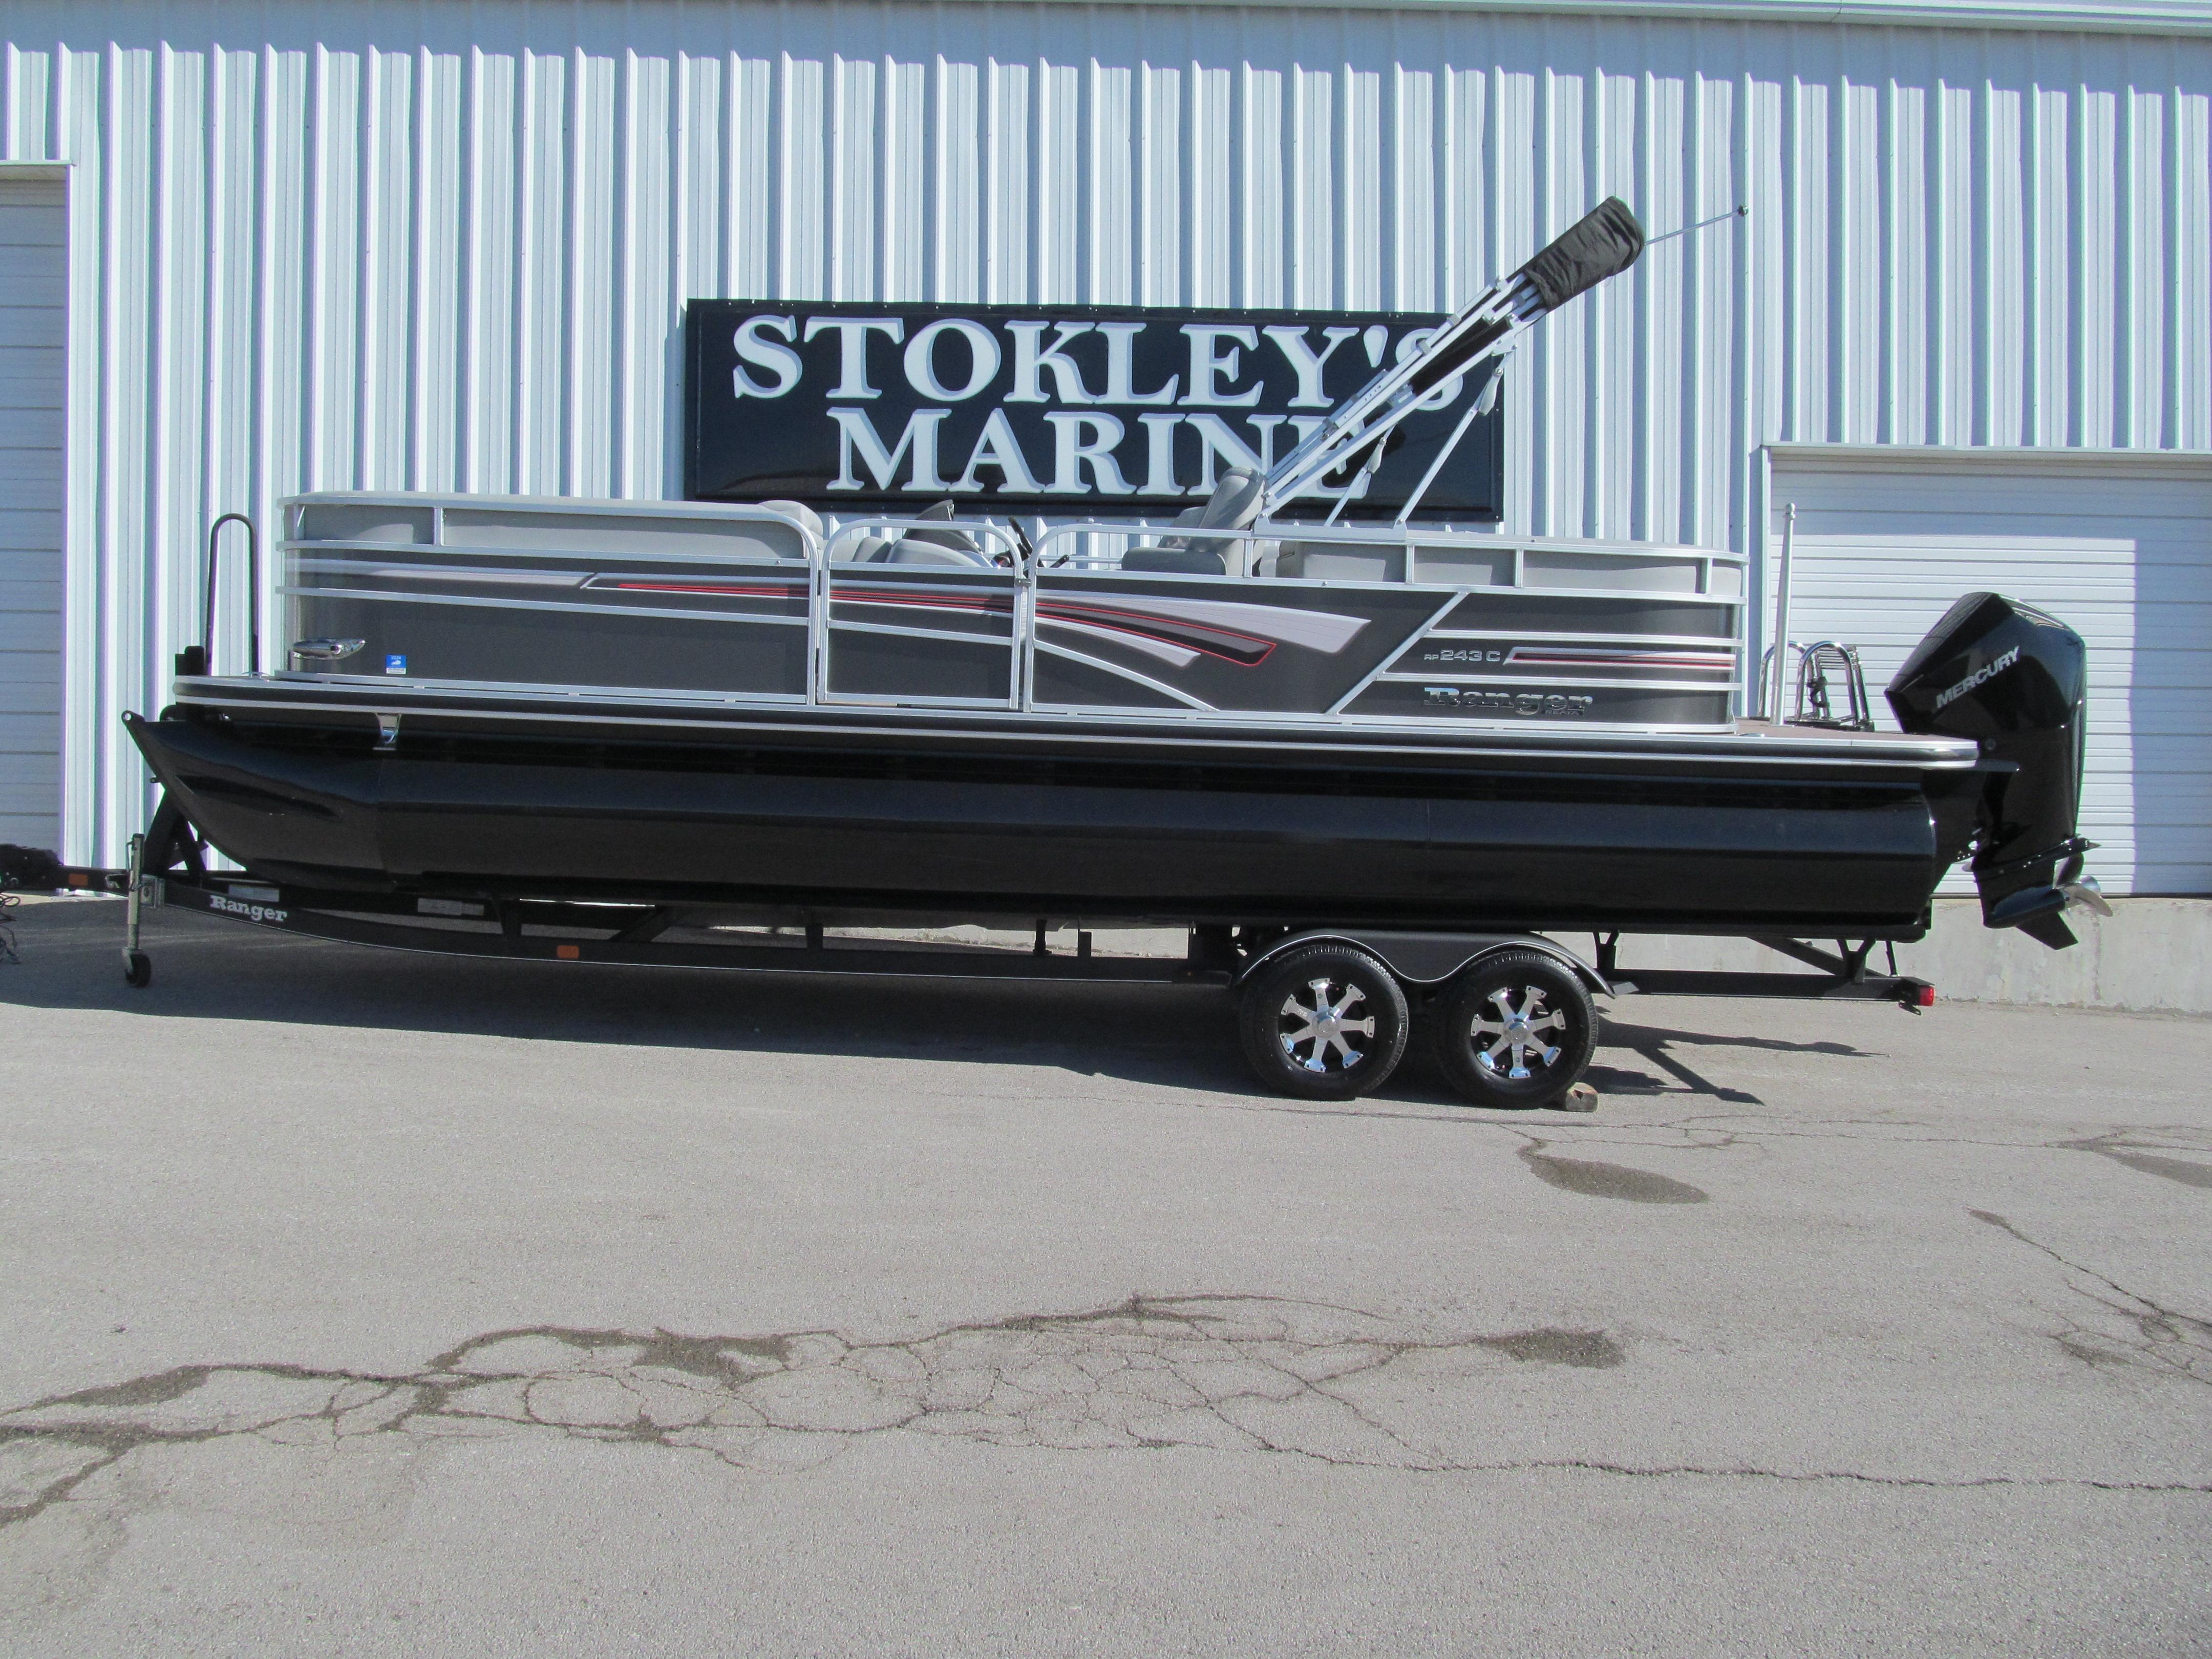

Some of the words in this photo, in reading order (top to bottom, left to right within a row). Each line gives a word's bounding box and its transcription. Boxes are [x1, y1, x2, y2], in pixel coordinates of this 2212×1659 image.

[1936, 646, 2020, 708] MERCURY
[1423, 687, 1593, 715] Ranger
[210, 895, 287, 922] Ranger
